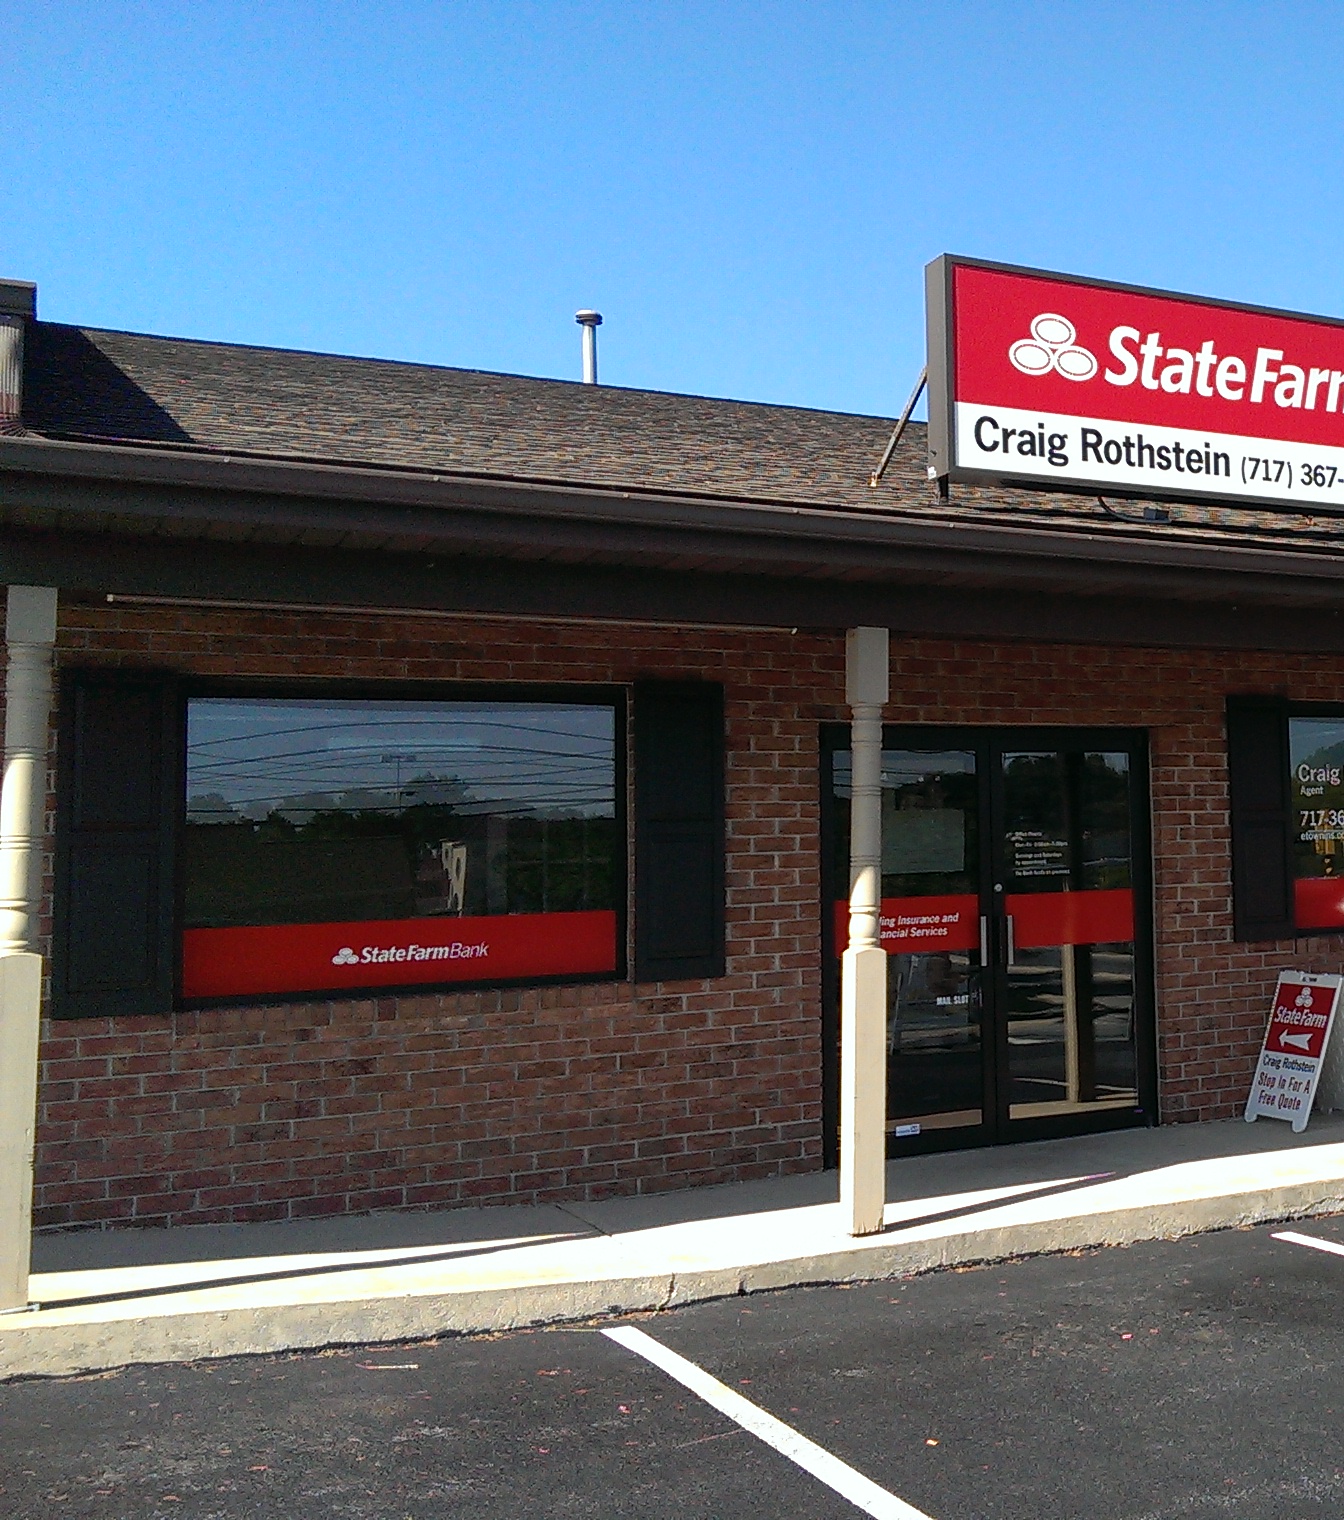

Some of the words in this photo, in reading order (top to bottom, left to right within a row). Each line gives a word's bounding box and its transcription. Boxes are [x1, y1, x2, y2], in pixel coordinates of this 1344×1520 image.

[974, 415, 1068, 466] Craig
[1081, 427, 1230, 477] Rothstein
[1241, 455, 1292, 488] (717)
[1298, 763, 1340, 785] Craig
[1300, 785, 1324, 797] Agent
[897, 914, 940, 926] Insurance
[941, 912, 960, 923] and
[910, 926, 948, 938] Services
[1263, 1054, 1281, 1070] Craig
[1282, 1057, 1316, 1073] Rothstein
[1258, 1071, 1276, 1089] Stop
[1288, 1076, 1303, 1092] For
[1303, 1079, 1311, 1094] A
[1258, 1089, 1276, 1106] Free
[1278, 1093, 1301, 1110] Quote
